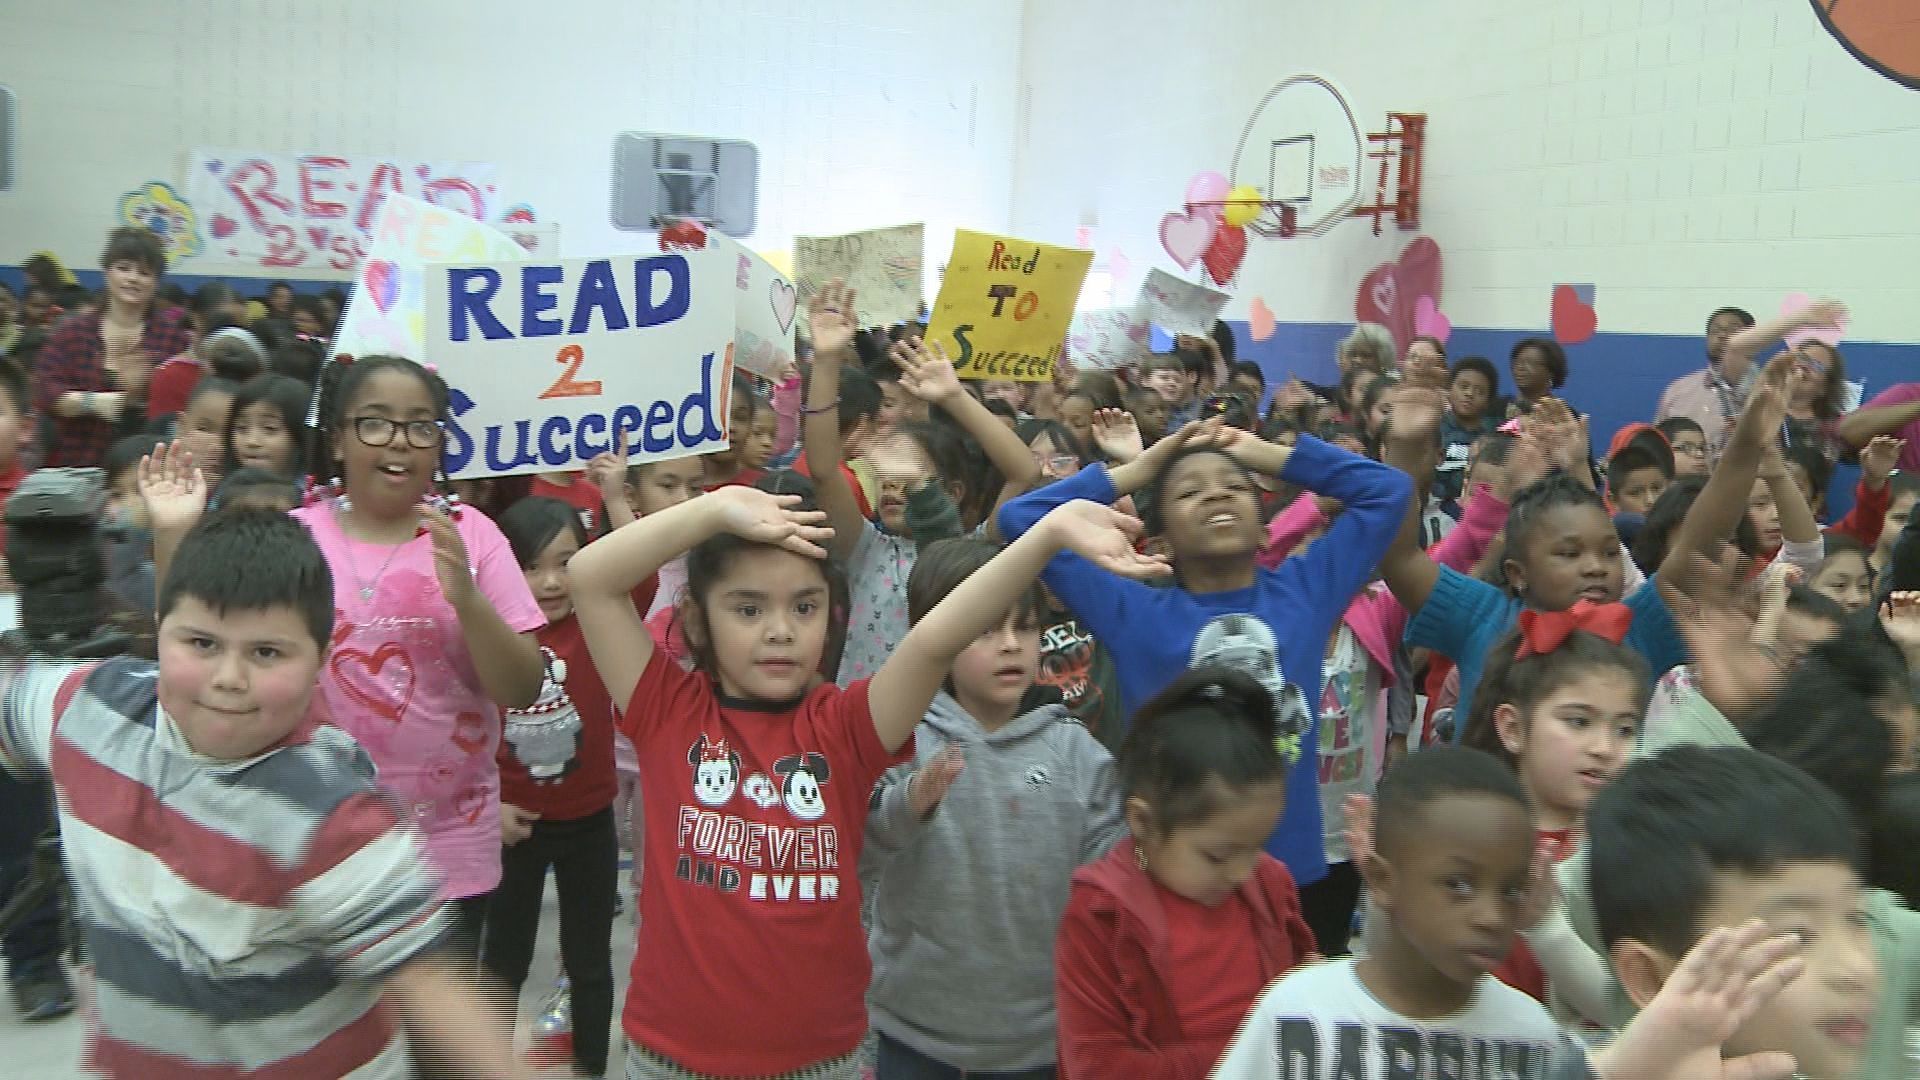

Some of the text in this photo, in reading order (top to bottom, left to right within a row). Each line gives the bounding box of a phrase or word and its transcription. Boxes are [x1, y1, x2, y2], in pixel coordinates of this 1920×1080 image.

[260, 225, 309, 269] 2
[988, 241, 1041, 276] Read
[447, 254, 691, 341] READ
[987, 285, 1040, 323] TO
[538, 344, 603, 399] 2
[442, 343, 734, 474] Succeed!
[677, 804, 839, 869] FOREVER
[676, 854, 839, 900] AND EVER
